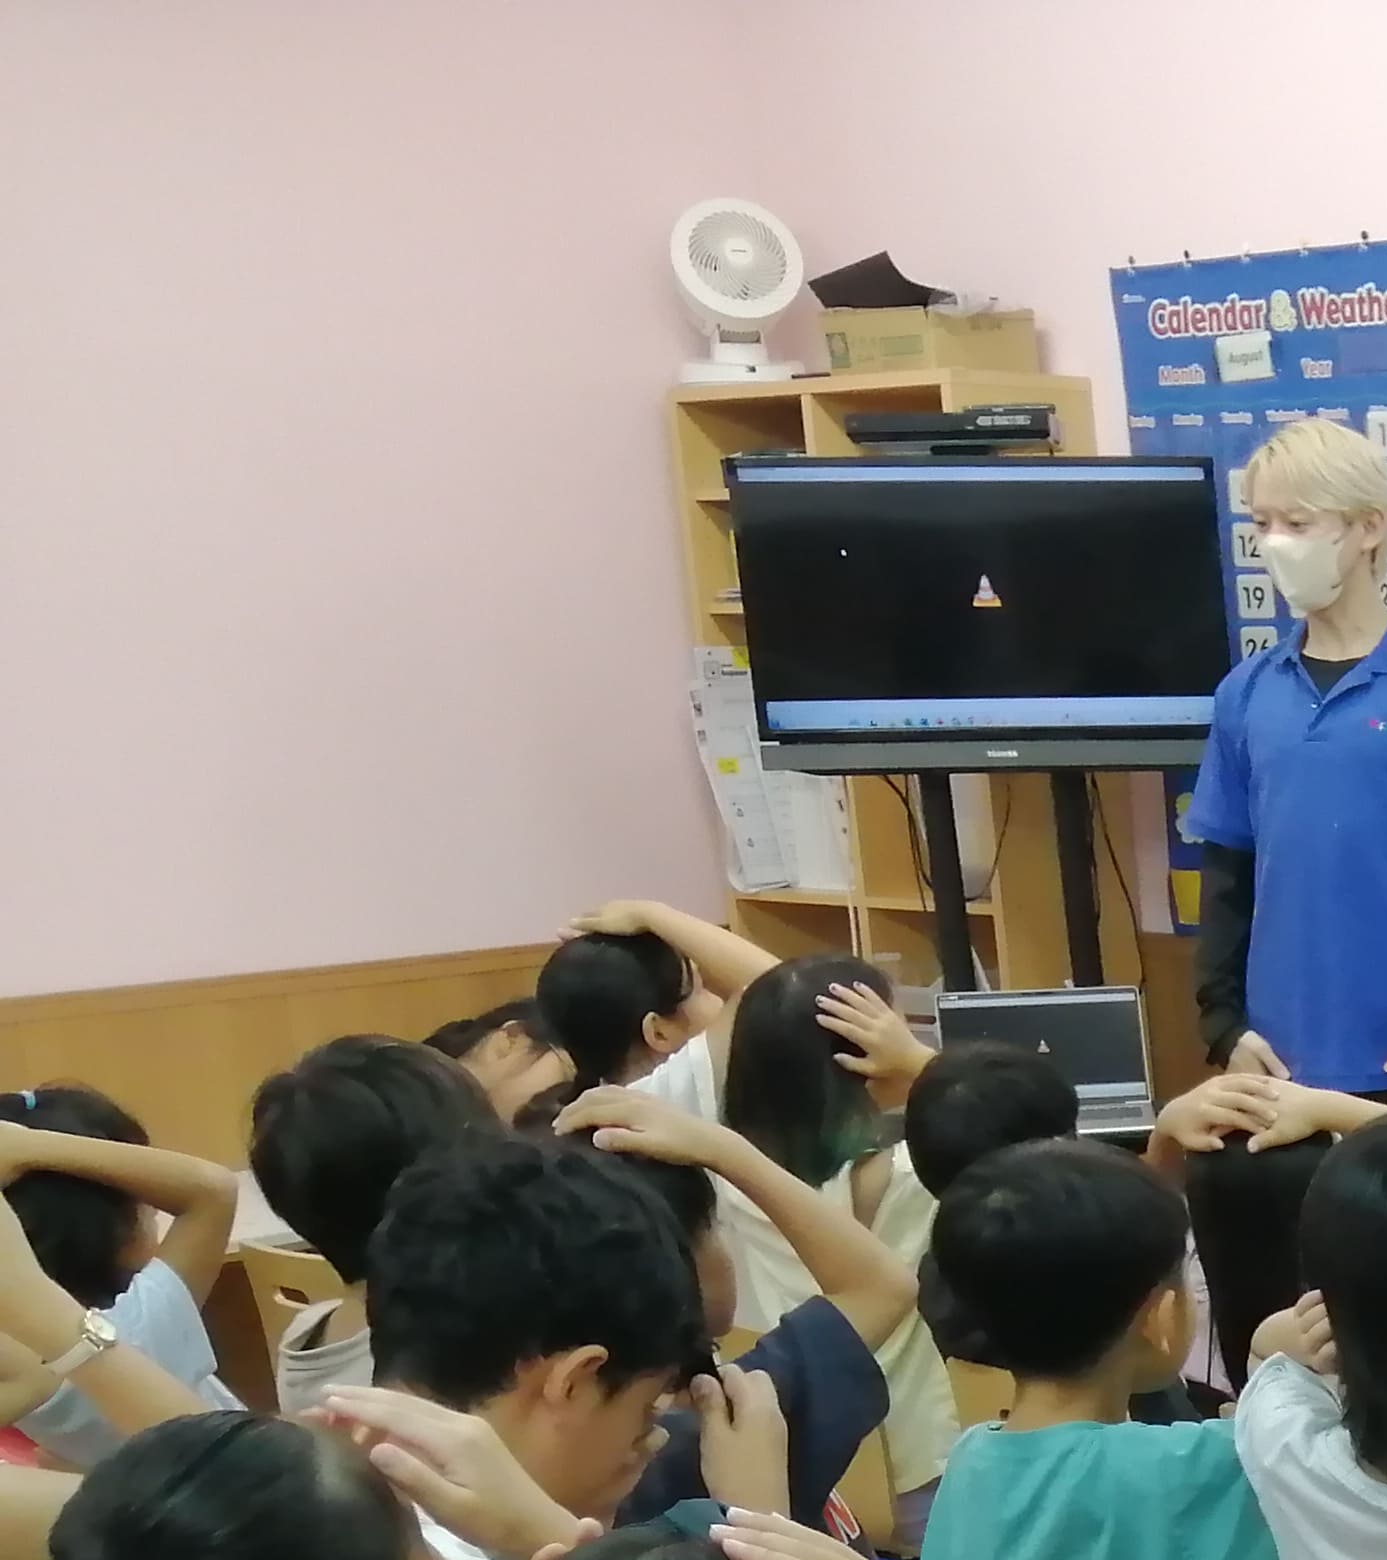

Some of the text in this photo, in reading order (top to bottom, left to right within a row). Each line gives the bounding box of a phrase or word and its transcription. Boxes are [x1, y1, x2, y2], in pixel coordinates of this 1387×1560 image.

[1150, 295, 1265, 337] Calendar
[1270, 290, 1297, 331] &
[1228, 349, 1263, 366] August
[1159, 358, 1332, 385] Month Year
[1378, 423, 1387, 446] 1
[1243, 586, 1264, 609] 19
